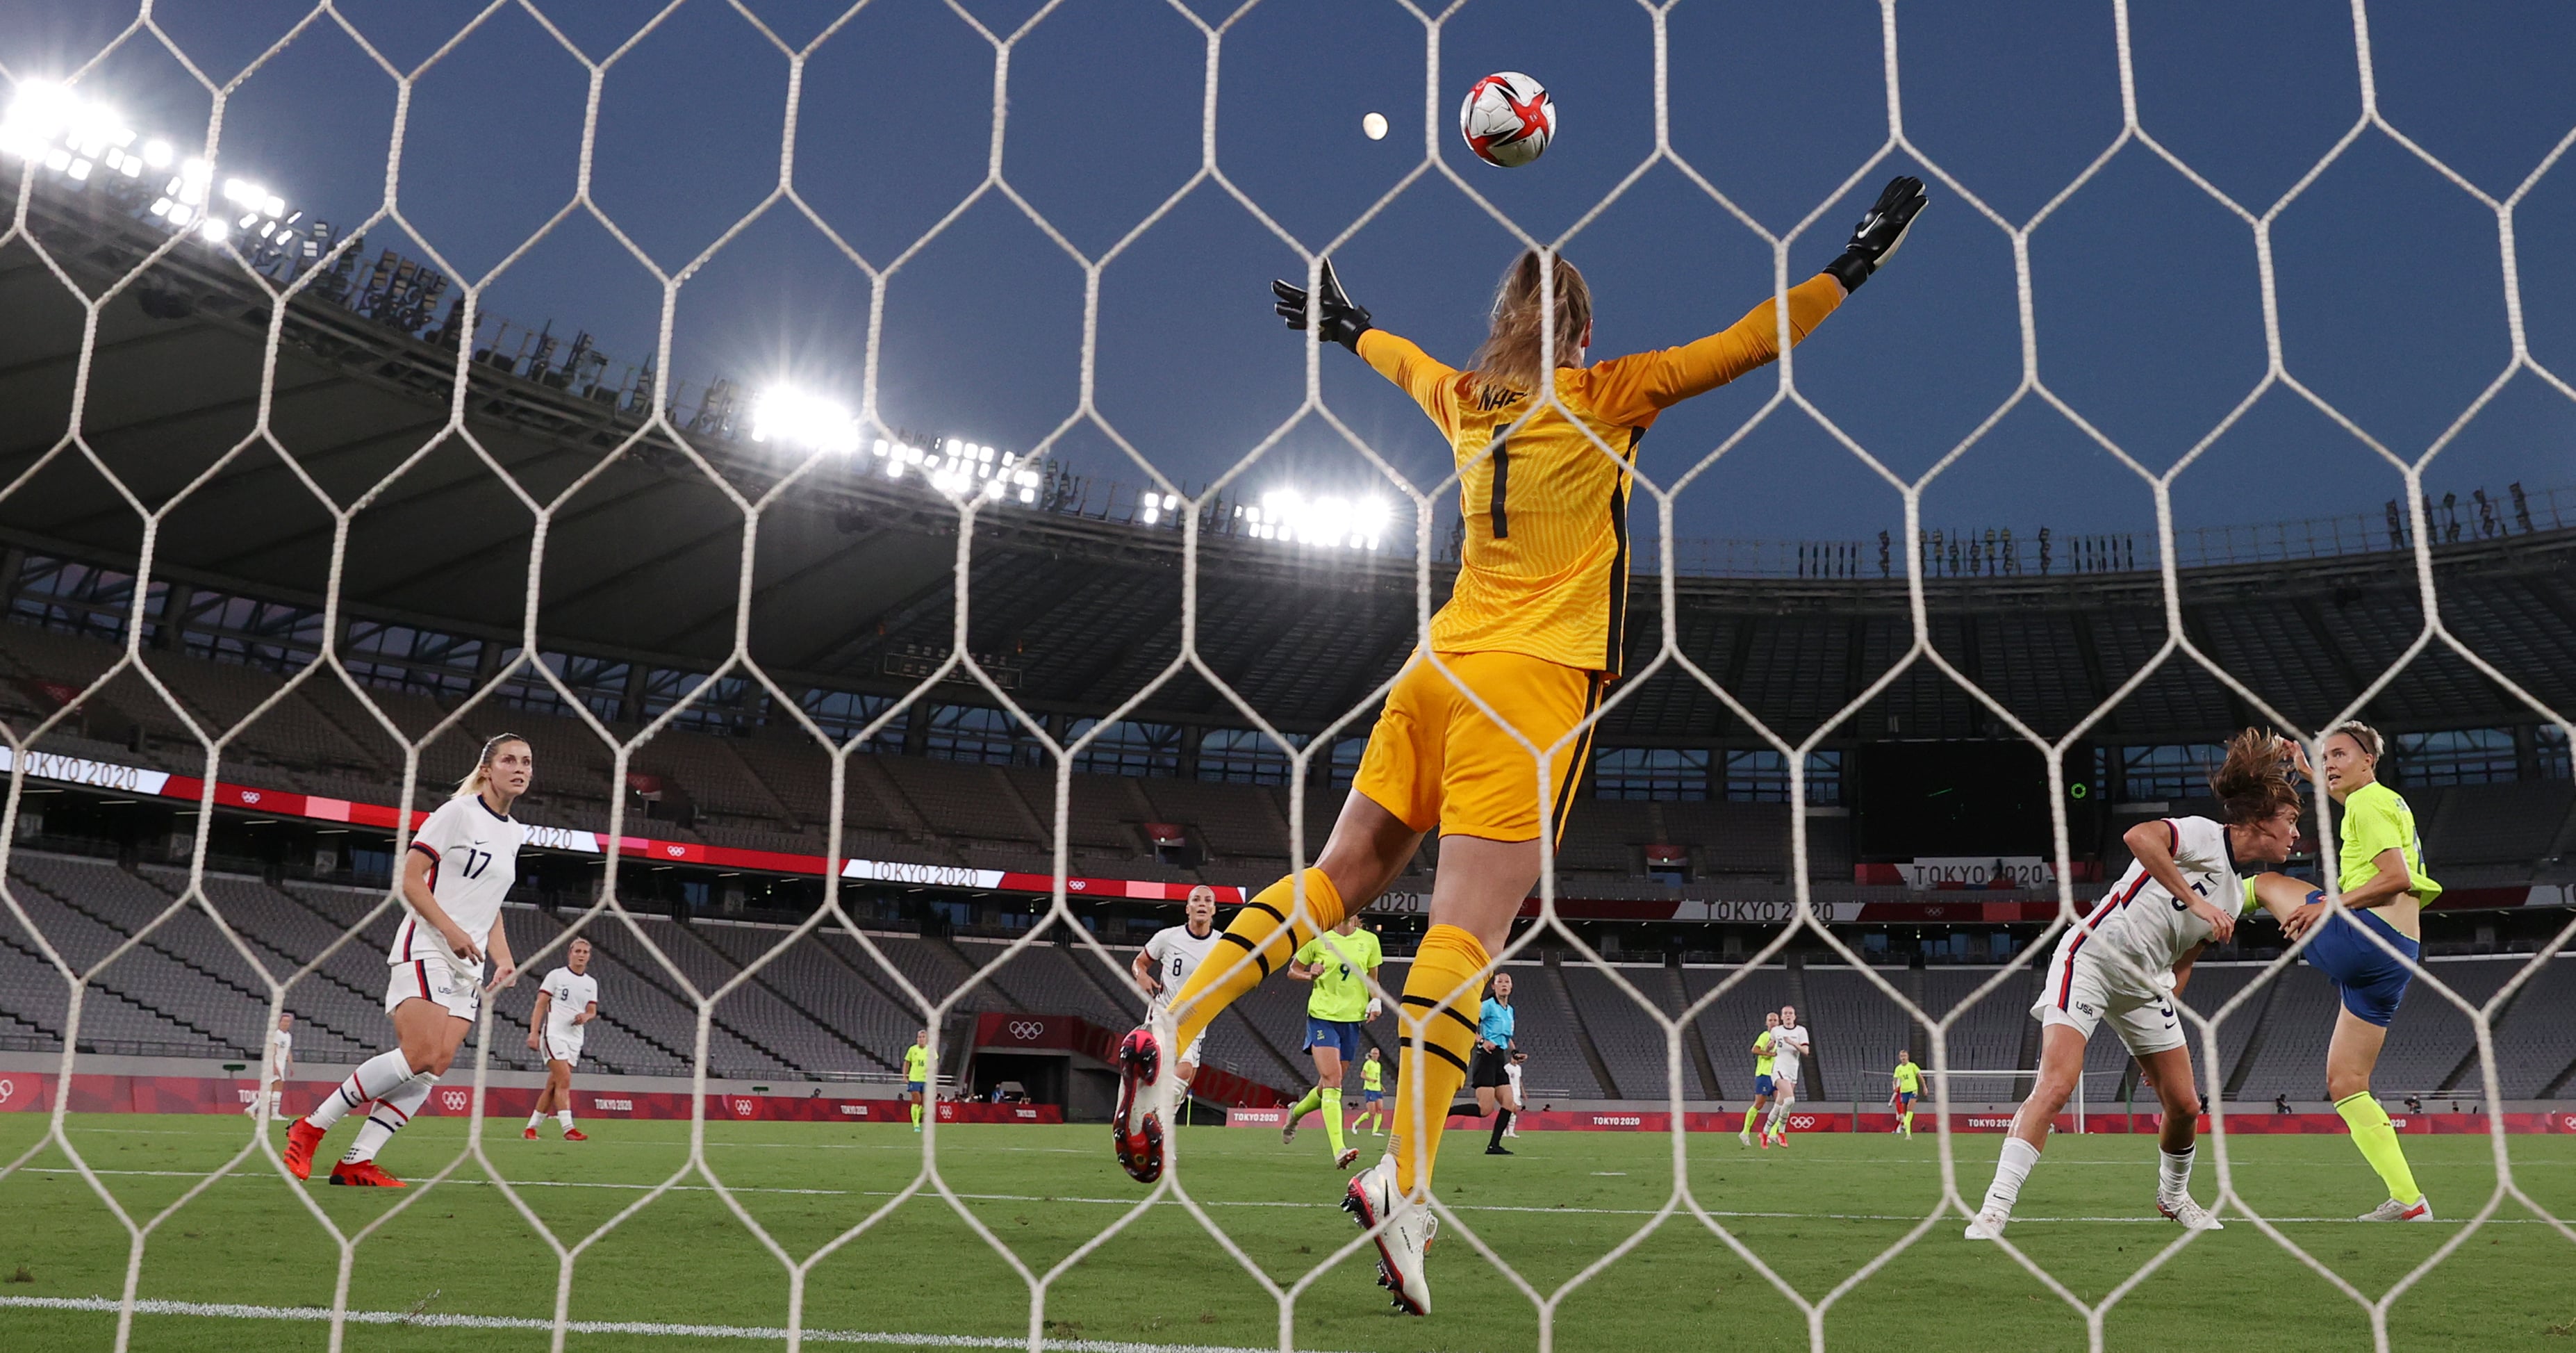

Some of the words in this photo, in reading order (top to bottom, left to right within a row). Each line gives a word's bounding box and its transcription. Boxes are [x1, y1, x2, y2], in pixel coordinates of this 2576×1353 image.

[1477, 384, 1527, 411] NAE
[1491, 423, 1511, 539] 1
[87, 762, 138, 789] 2020
[526, 826, 572, 850] 2020
[462, 848, 492, 880] 17
[870, 860, 929, 884] TOKYO
[934, 866, 978, 887] 2020
[1914, 865, 1985, 885] TOKYO
[1703, 901, 1776, 921] TOKYO
[1781, 902, 1834, 921] 220
[1172, 958, 1182, 977] 8
[1339, 962, 1351, 981] 9
[561, 988, 569, 1001] 9
[2075, 1000, 2094, 1018] USA
[238, 1088, 261, 1104] TOK
[1203, 1068, 1262, 1107] 020
[1234, 1113, 1259, 1122] TOKYO
[1260, 1113, 1279, 1122] 2020
[1593, 1117, 1619, 1126] TOKYO
[1620, 1117, 1640, 1126] 2020
[1968, 1118, 1996, 1127] TOKYO
[1997, 1118, 2013, 1128] 202
[2391, 1119, 2406, 1128] 020
